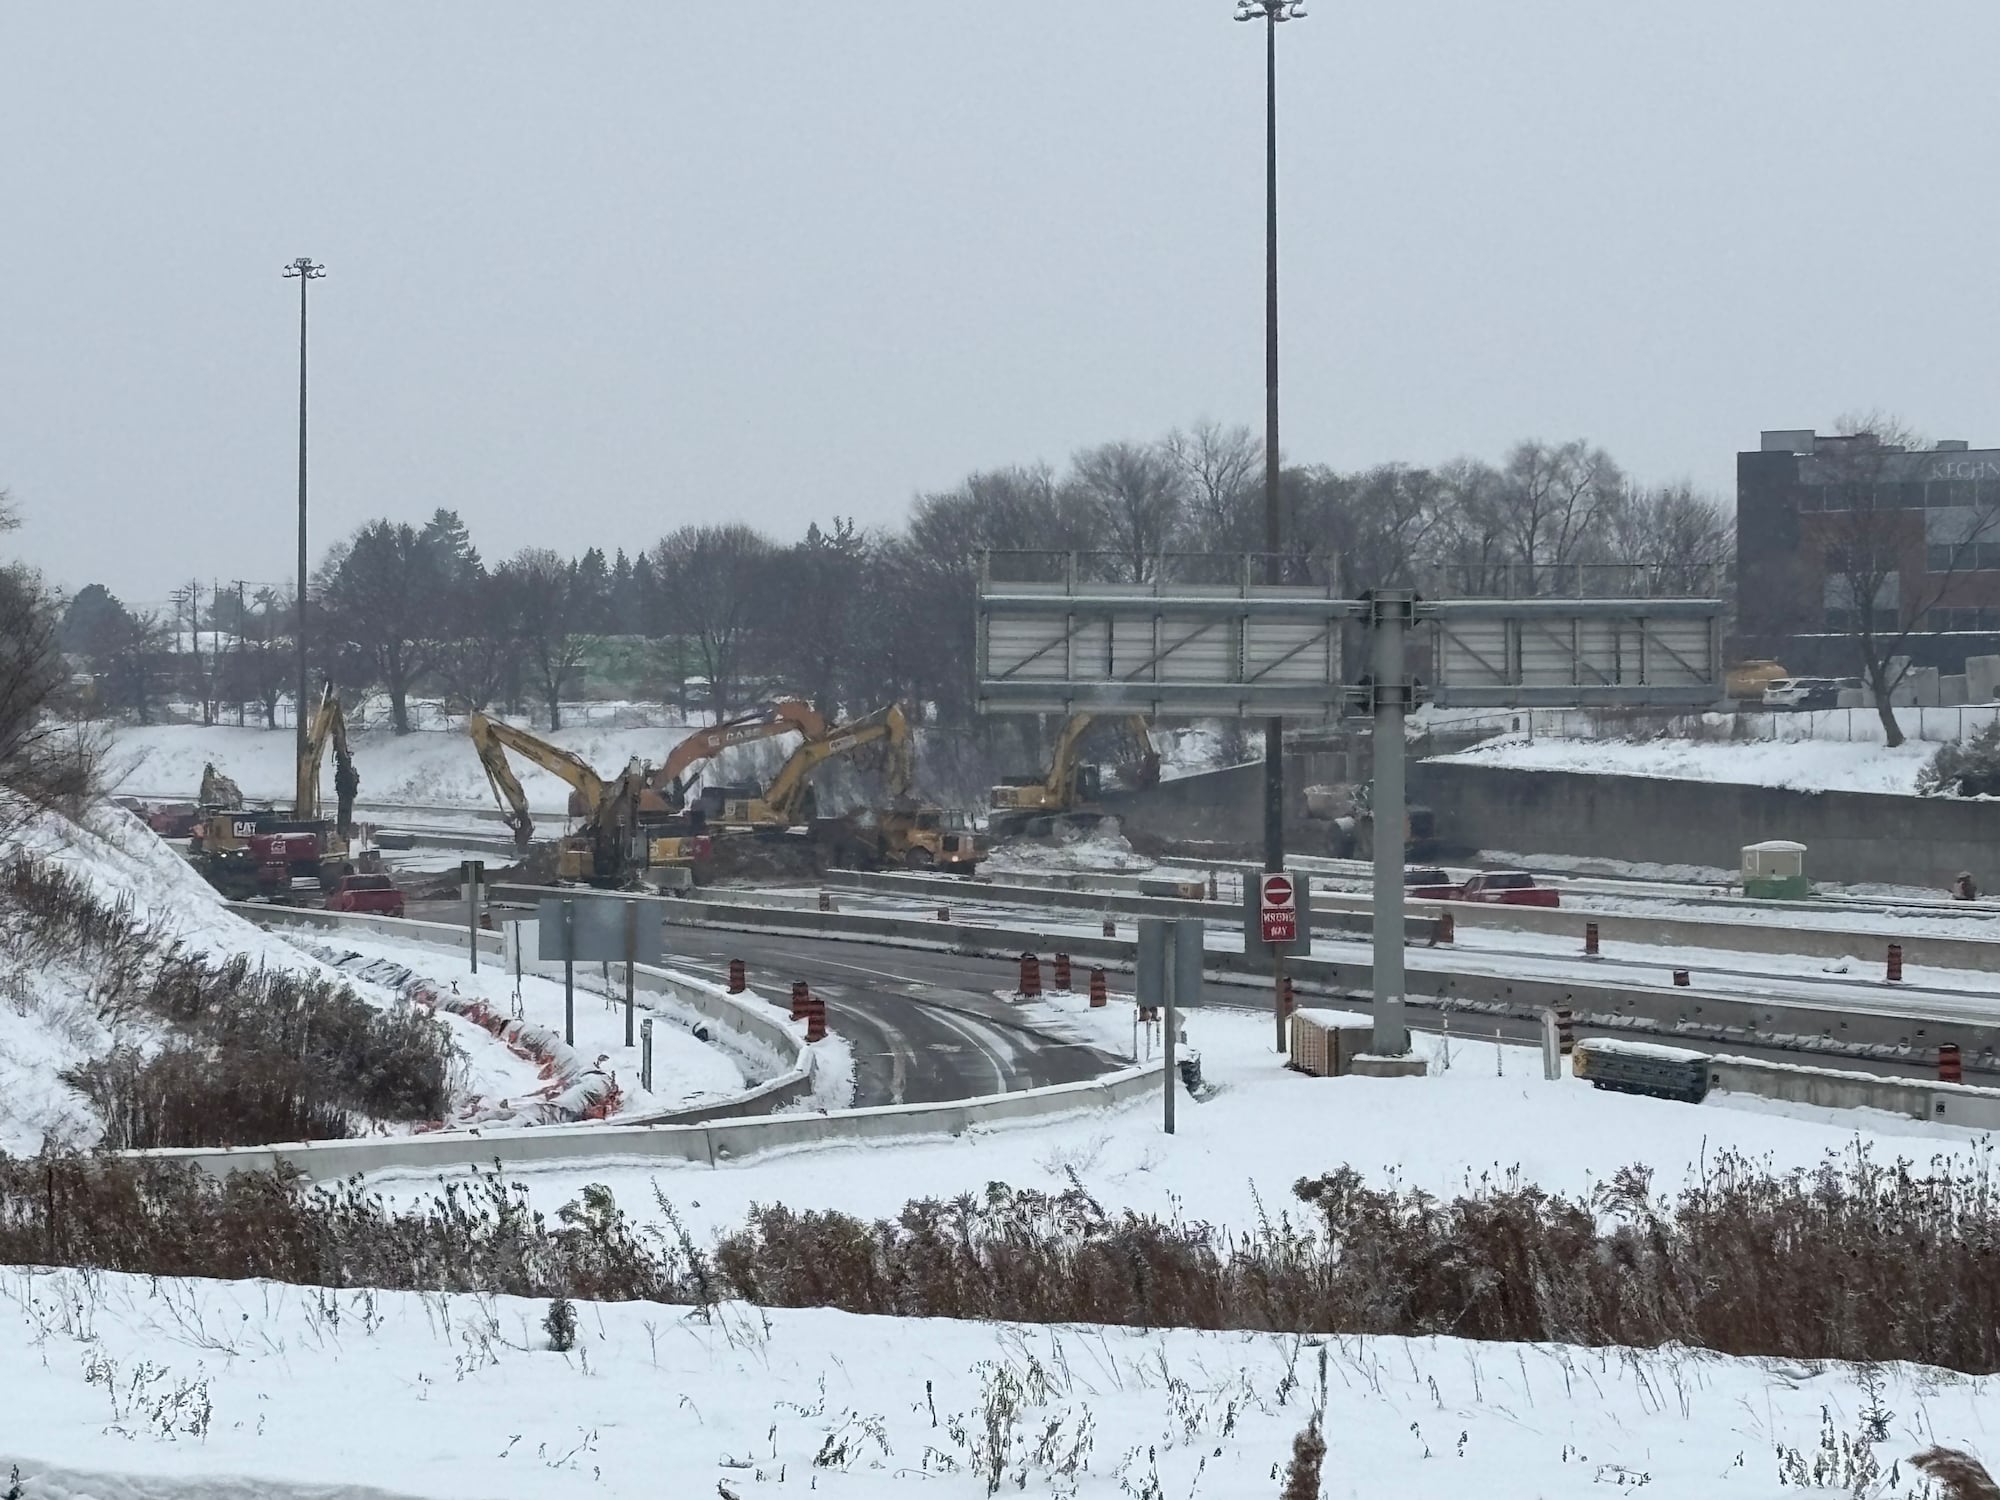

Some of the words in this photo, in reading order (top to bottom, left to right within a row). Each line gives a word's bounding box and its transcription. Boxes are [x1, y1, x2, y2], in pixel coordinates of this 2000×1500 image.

[233, 821, 257, 837] CAT
[1263, 912, 1295, 923] WRONG
[1270, 926, 1287, 937] WAY
